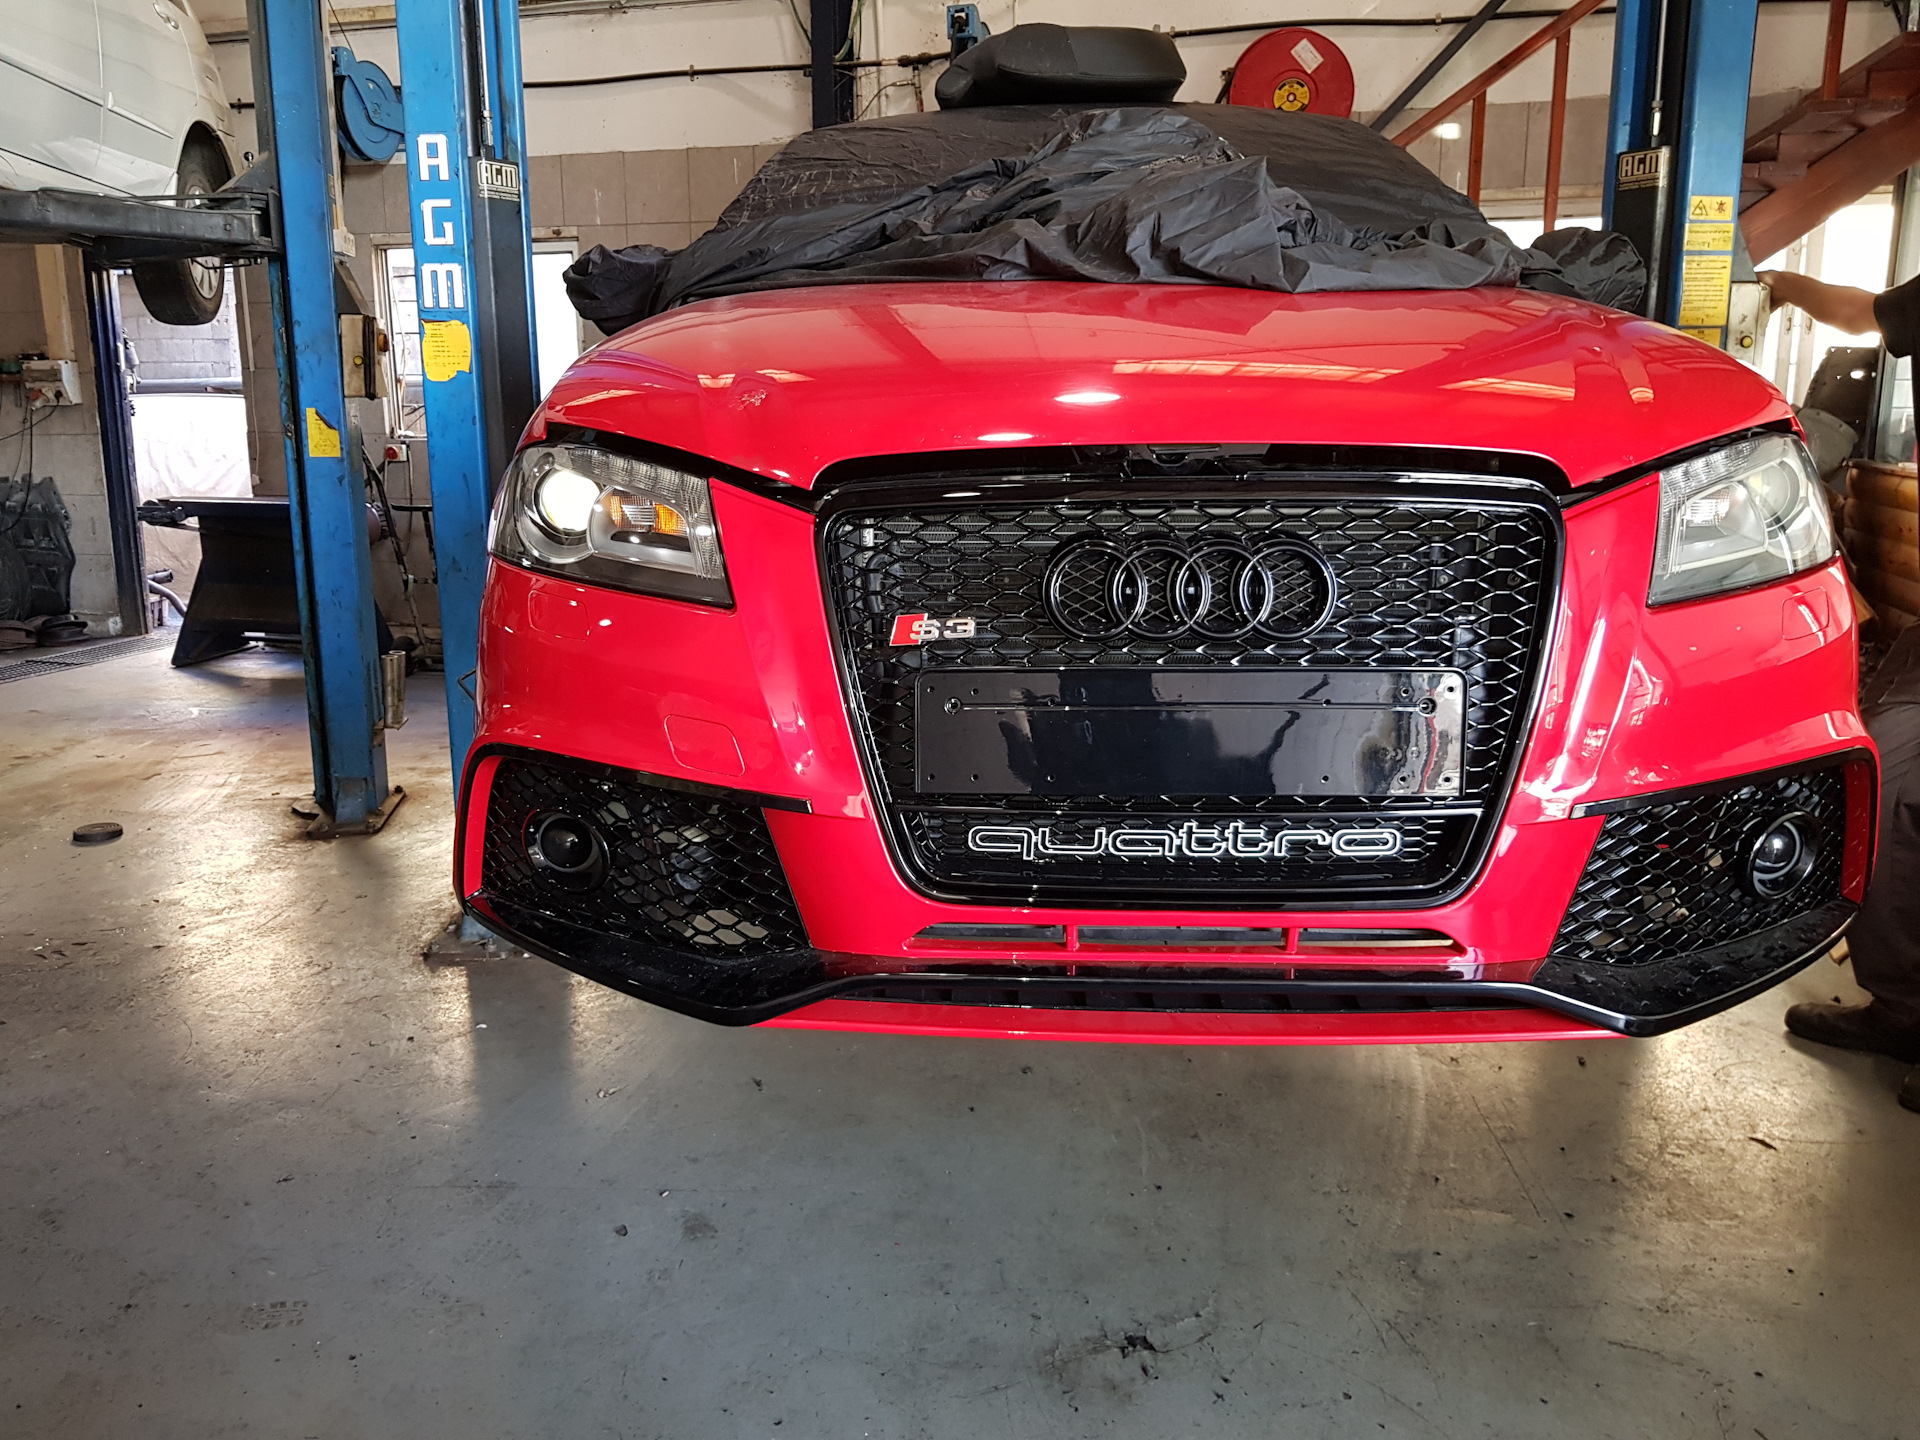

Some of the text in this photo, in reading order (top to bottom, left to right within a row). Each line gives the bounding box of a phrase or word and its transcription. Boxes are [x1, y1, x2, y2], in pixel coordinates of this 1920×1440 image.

[480, 163, 517, 188] AGM
[417, 133, 465, 309] AGM
[909, 616, 976, 641] S3
[968, 821, 1401, 860] quattro
